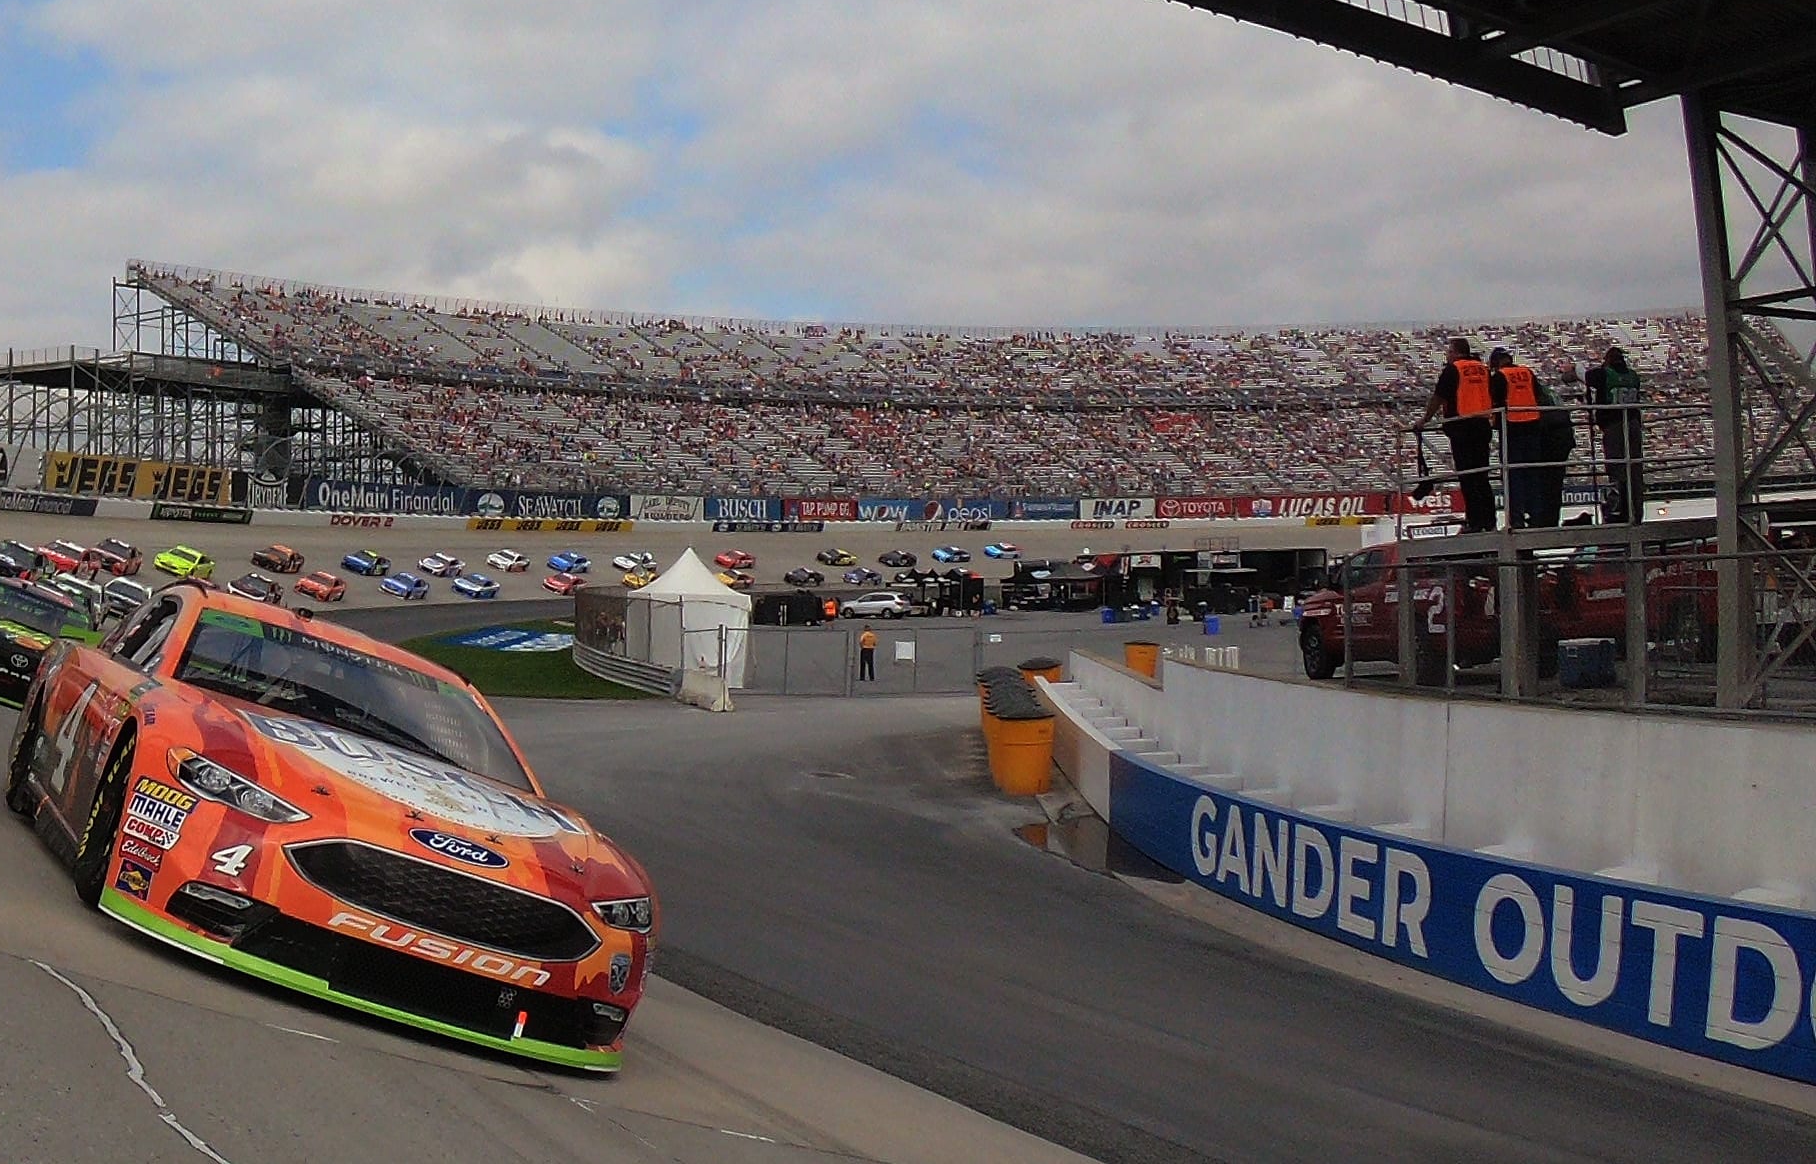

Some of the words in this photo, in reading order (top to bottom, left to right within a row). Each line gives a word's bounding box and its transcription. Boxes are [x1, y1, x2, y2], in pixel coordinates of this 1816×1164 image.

[55, 456, 136, 496] JEGS
[153, 463, 222, 503] JEGS
[35, 496, 73, 515] Financial
[318, 482, 389, 509] OneMain
[392, 489, 455, 512] Financial
[718, 498, 767, 518] BUSCH
[948, 504, 991, 521] pepsi
[1093, 500, 1141, 517] INAP
[1183, 502, 1225, 513] TOYOTA
[1279, 498, 1335, 518] LUCAS
[1339, 496, 1365, 516] OIL
[330, 514, 382, 528] DOVER
[384, 516, 394, 528] 2
[51, 684, 98, 796] 4
[135, 779, 197, 811] MOOG
[130, 794, 186, 829] MAHLE
[211, 844, 254, 877] 4
[429, 833, 490, 867] Ford
[1190, 795, 1432, 958] GANDER
[1474, 873, 1816, 1050] OUTD
[327, 912, 551, 987] FUSION
